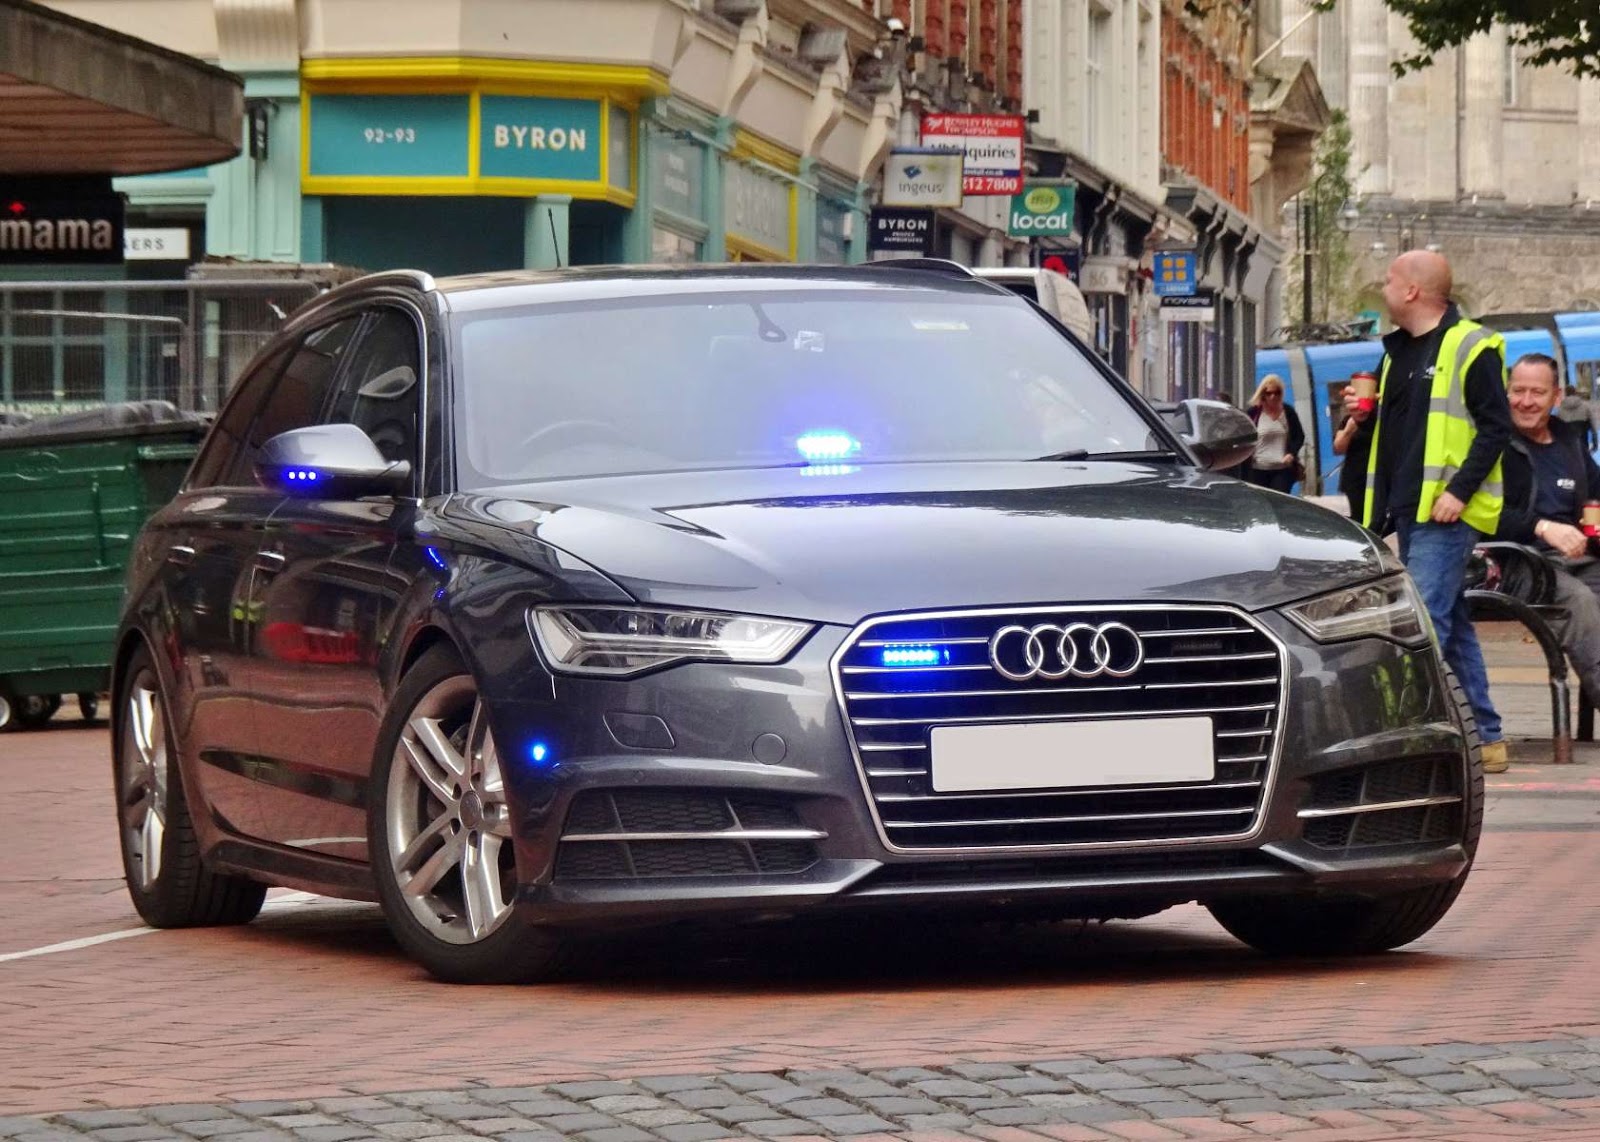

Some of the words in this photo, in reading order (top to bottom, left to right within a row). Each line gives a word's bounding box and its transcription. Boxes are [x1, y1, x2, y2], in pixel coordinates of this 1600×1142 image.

[364, 127, 416, 143] 92-93
[494, 124, 587, 151] BYRON
[898, 182, 943, 197] ingeus
[986, 177, 1018, 191] 7800
[878, 219, 928, 232] BYRON
[1013, 211, 1068, 230] local
[0, 218, 113, 251] mama
[123, 238, 165, 251] ERS
